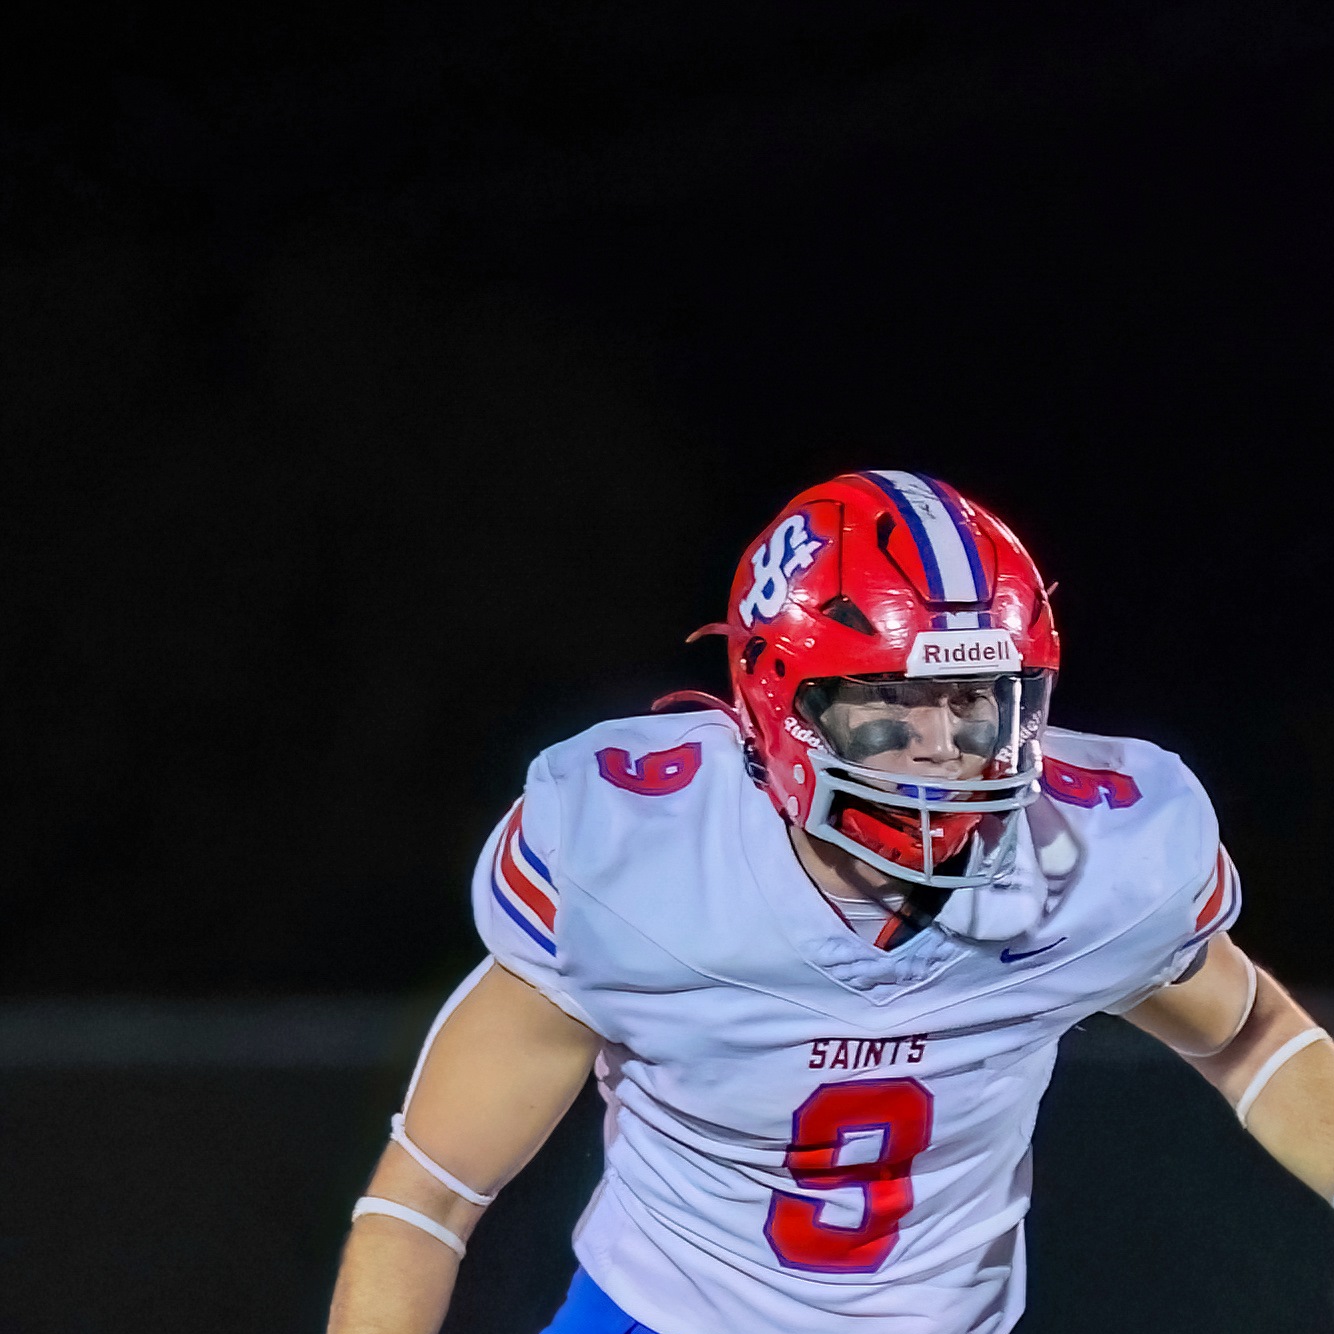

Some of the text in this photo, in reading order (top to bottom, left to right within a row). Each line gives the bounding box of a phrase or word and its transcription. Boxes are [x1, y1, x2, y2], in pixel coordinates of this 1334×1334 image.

[924, 640, 1011, 664] Riddell
[594, 742, 703, 797] 9
[808, 1032, 930, 1070] SAINTS
[763, 1075, 936, 1275] 9
